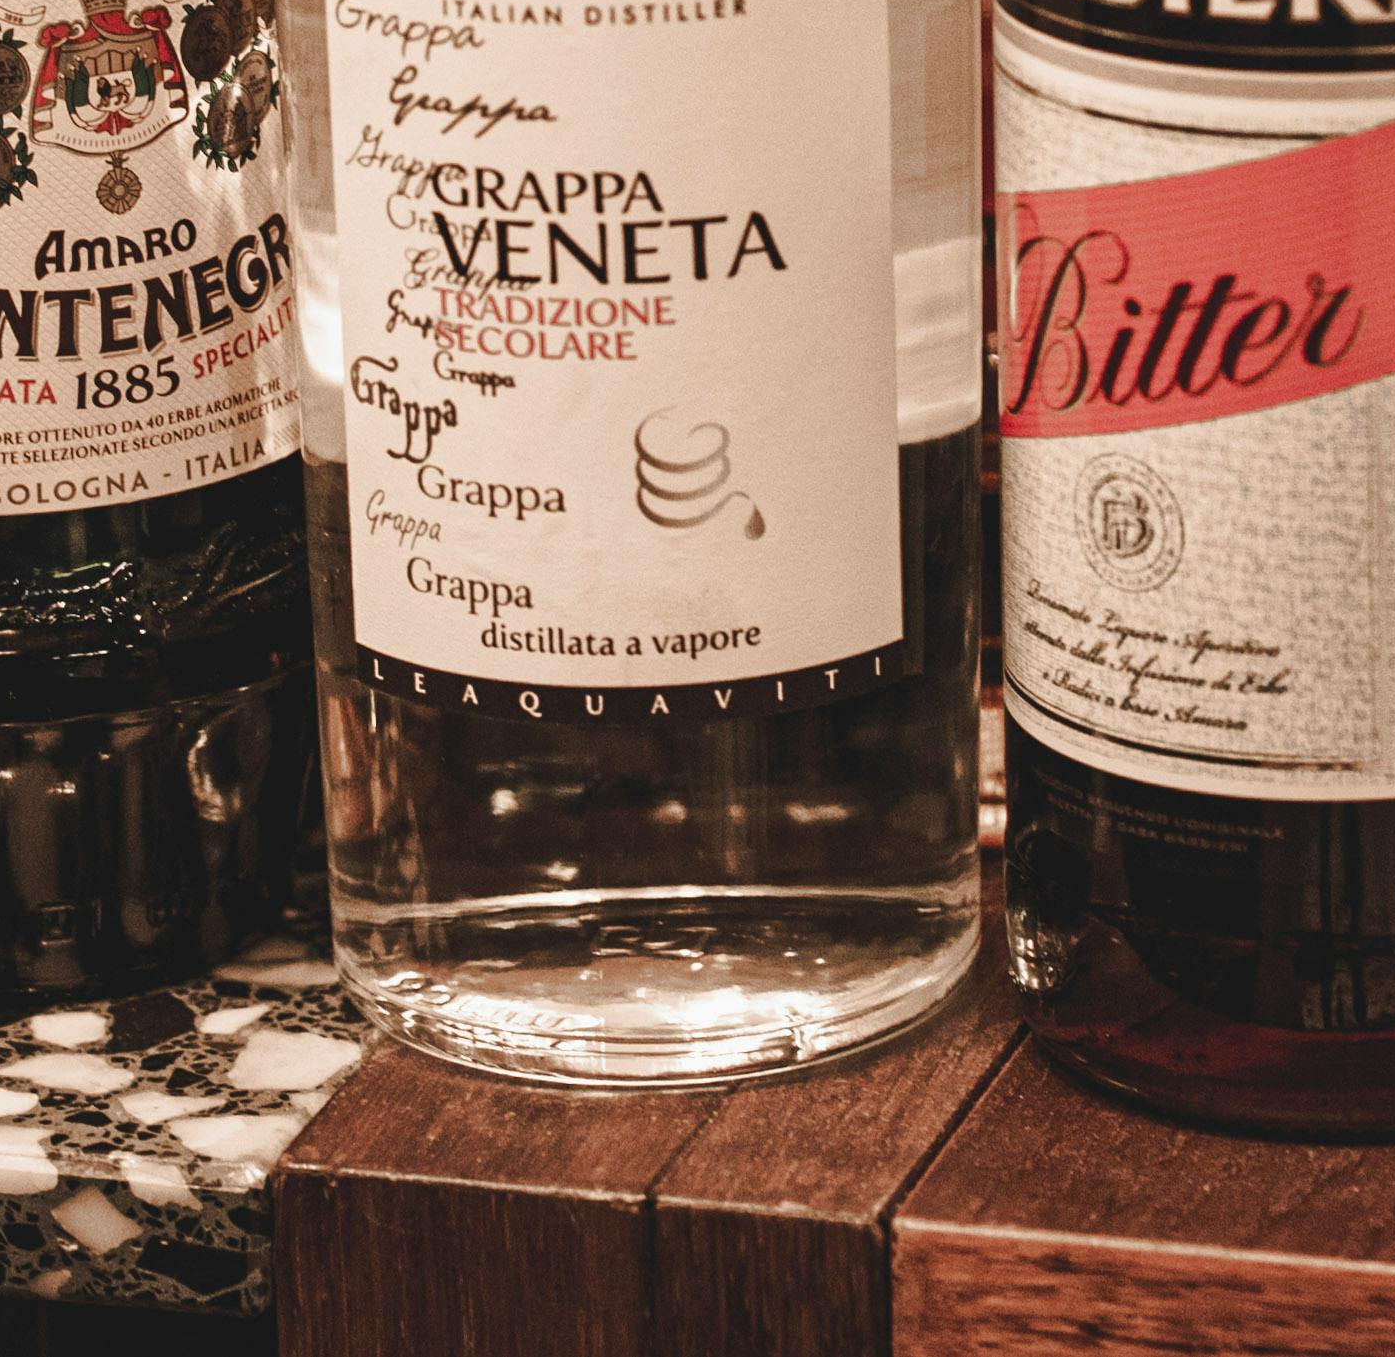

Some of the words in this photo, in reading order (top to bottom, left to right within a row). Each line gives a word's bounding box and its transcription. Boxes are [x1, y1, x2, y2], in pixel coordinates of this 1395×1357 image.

[443, 0, 562, 26] ITALIAN
[390, 65, 556, 140] Grappa
[432, 162, 664, 214] GRAPPA
[432, 210, 787, 285] VENETA
[432, 286, 676, 328] TRADIZIONE
[1008, 206, 1364, 414] Bitter
[435, 320, 638, 361] SECOLARE
[74, 355, 181, 410] 1885
[433, 349, 516, 398] Grappa
[23, 440, 130, 464] SELEZIONATE
[132, 424, 206, 452] SECONDO
[209, 411, 237, 434] UNA
[237, 398, 284, 423] RICETTA
[28, 421, 117, 444] OTTENUTO
[121, 419, 143, 434] DA
[146, 413, 164, 429] 40
[168, 405, 202, 425] ERBE
[206, 377, 282, 416] AROMATICHE
[350, 355, 458, 464] Grappa
[185, 438, 266, 481] ITALIA
[366, 489, 442, 550] Grappa
[418, 464, 566, 521] Grappa
[407, 556, 534, 618] Grappa
[481, 621, 617, 658] distillata
[626, 633, 643, 658] a
[652, 624, 762, 661] vapore
